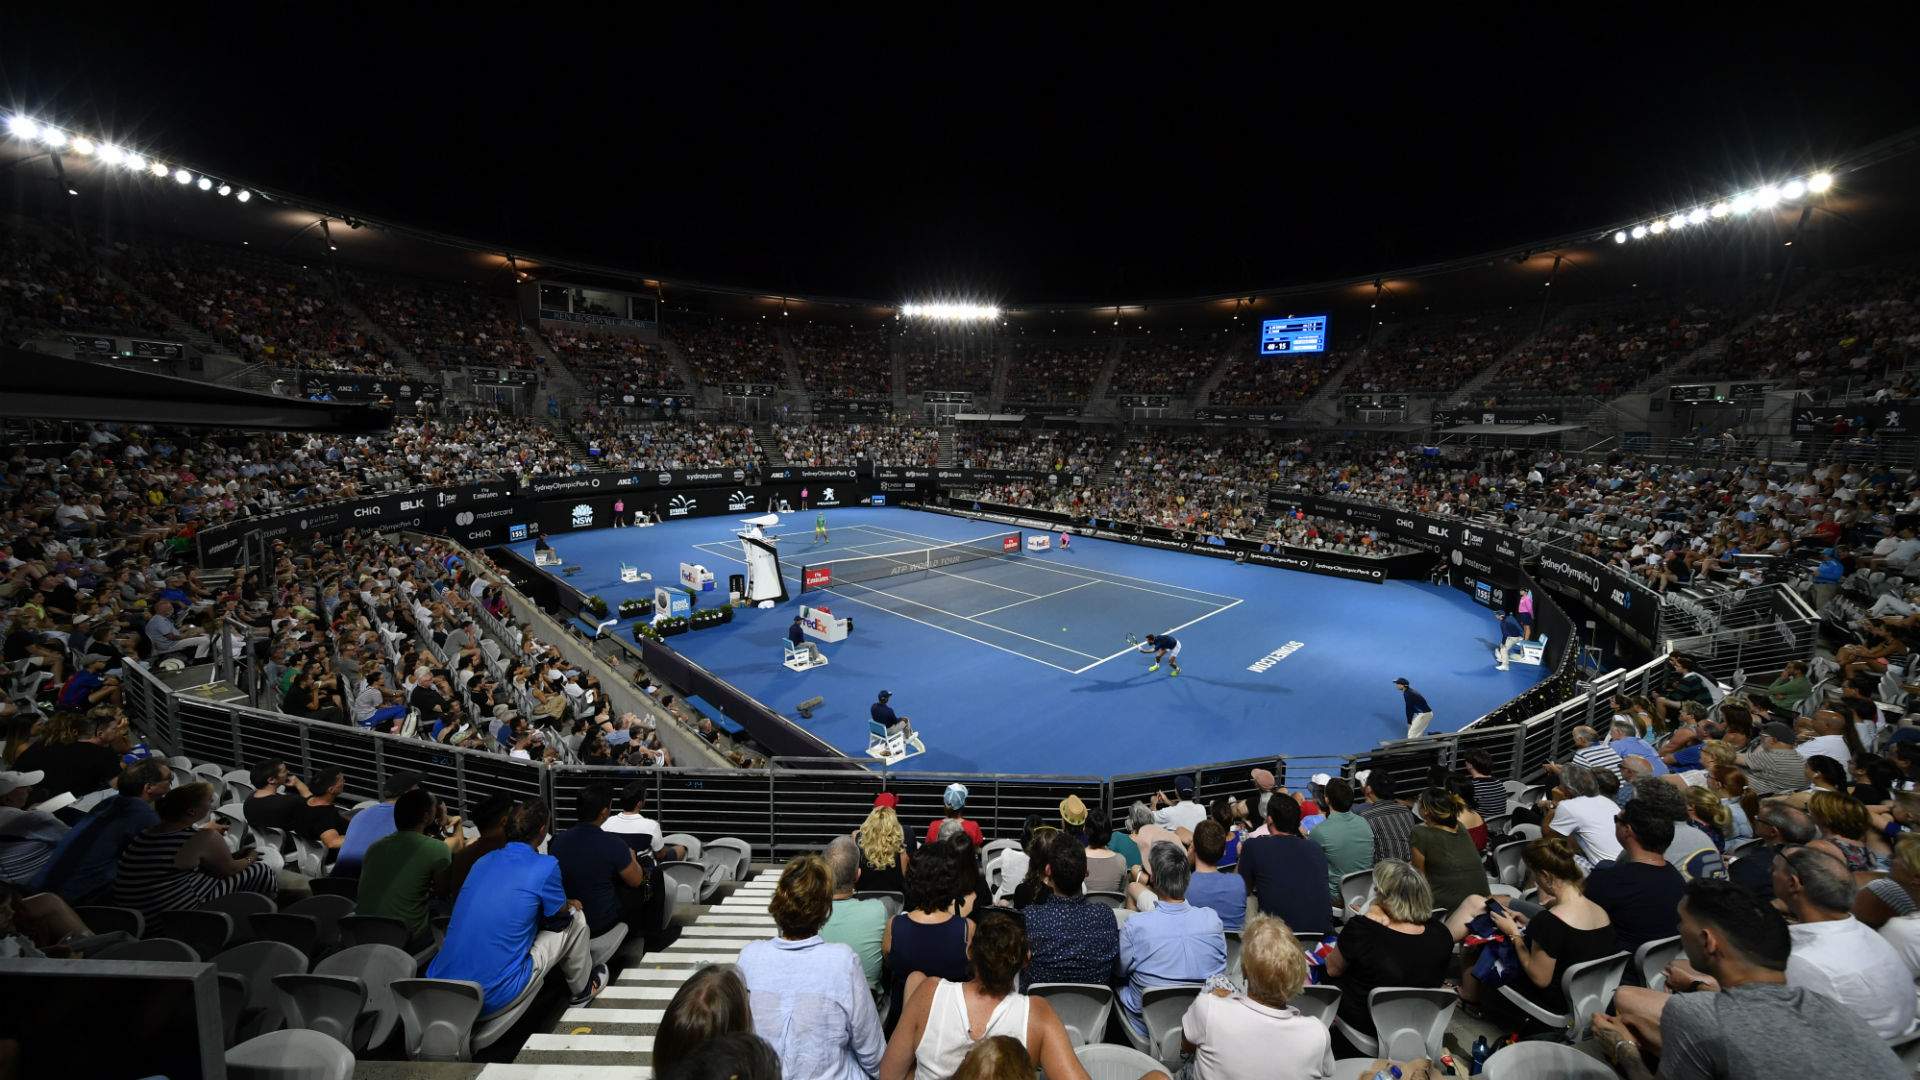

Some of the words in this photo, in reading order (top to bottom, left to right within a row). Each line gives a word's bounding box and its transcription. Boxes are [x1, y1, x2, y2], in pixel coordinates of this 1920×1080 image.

[686, 473, 723, 481] sydney.com
[801, 470, 847, 478] SydneyOlympicPark
[534, 480, 590, 493] SydneyOlympicPark
[617, 478, 632, 486] ANZ
[473, 492, 499, 501] Emirates
[400, 499, 425, 511] BLK
[476, 508, 513, 520] mastercard
[572, 516, 593, 526] NSW
[1427, 525, 1449, 538] BLK
[1250, 553, 1298, 565] SydneyOlympicPark
[890, 565, 907, 575] ATP
[910, 559, 939, 571] WORLD
[940, 556, 961, 566] TOUR
[1314, 563, 1370, 576] SydneyOlympicPark
[1463, 557, 1492, 574] mastercard
[1540, 555, 1593, 588] SydneyOlympicPark
[807, 576, 829, 585] Emirates
[1610, 588, 1625, 606] ANZ
